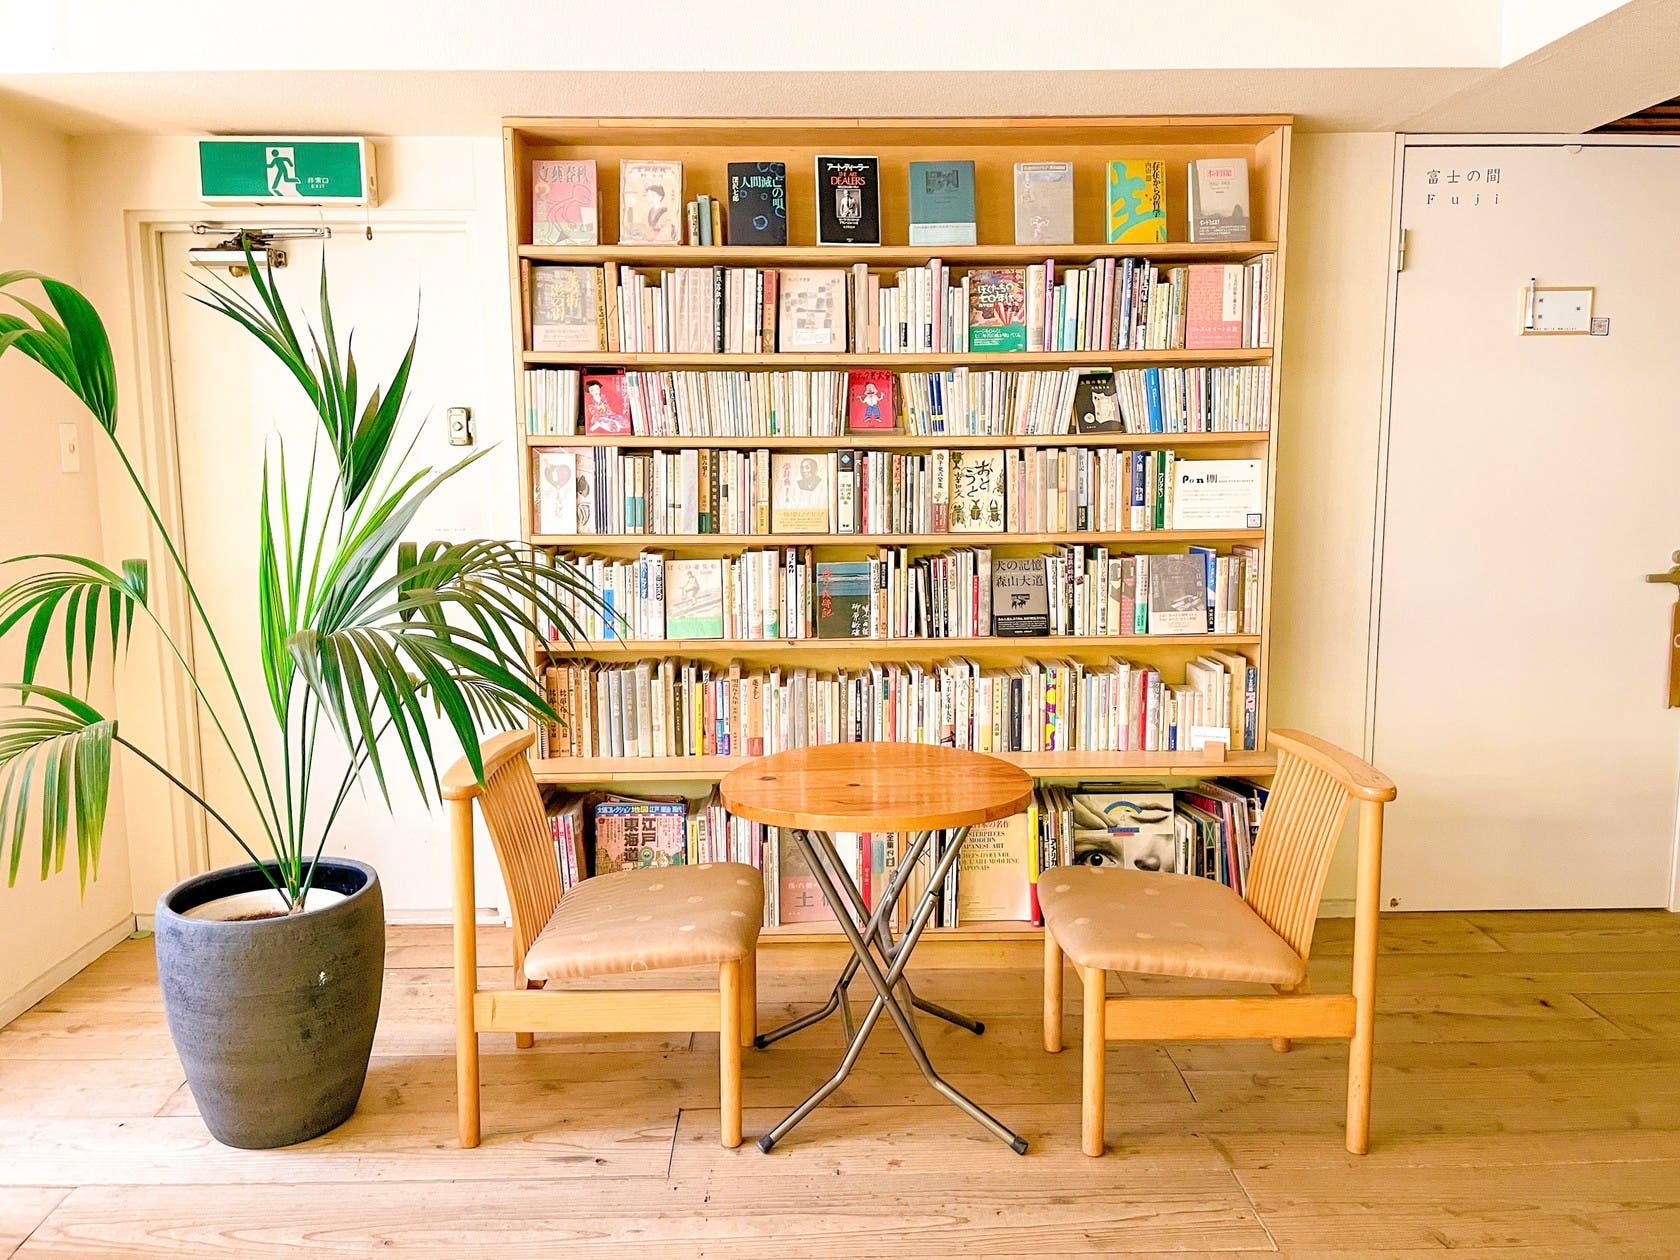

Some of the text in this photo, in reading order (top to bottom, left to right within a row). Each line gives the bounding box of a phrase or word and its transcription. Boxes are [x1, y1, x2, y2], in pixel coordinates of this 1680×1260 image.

[830, 176, 866, 186] DEALERS
[1426, 168, 1502, 185] 富士の間
[1182, 475, 1204, 484] Pon
[995, 559, 1043, 572] 犬の記憶
[995, 575, 1045, 588] 森山大道
[641, 817, 656, 847] 江戸
[624, 817, 639, 862] 東海道
